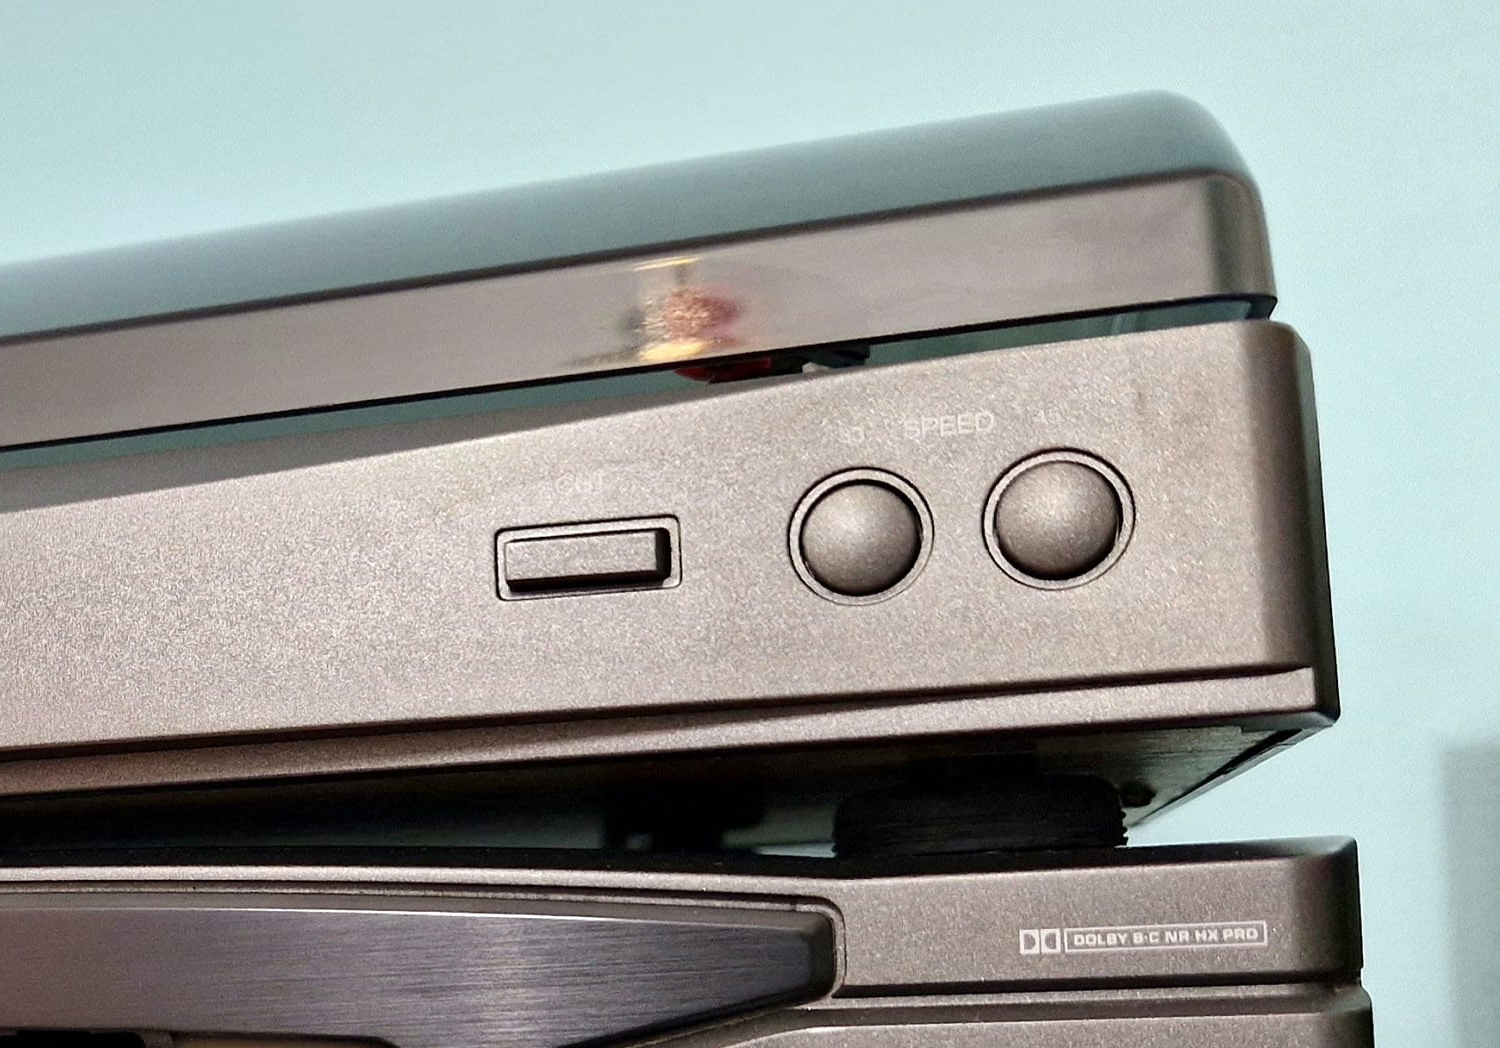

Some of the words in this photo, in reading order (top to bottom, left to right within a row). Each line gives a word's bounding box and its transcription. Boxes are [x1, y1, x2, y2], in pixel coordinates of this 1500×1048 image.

[904, 410, 996, 442] SPEED
[1073, 932, 1128, 947] DOLBY
[1164, 929, 1190, 943] NR
[1194, 927, 1218, 943] HX
[1222, 927, 1260, 942] PRO
